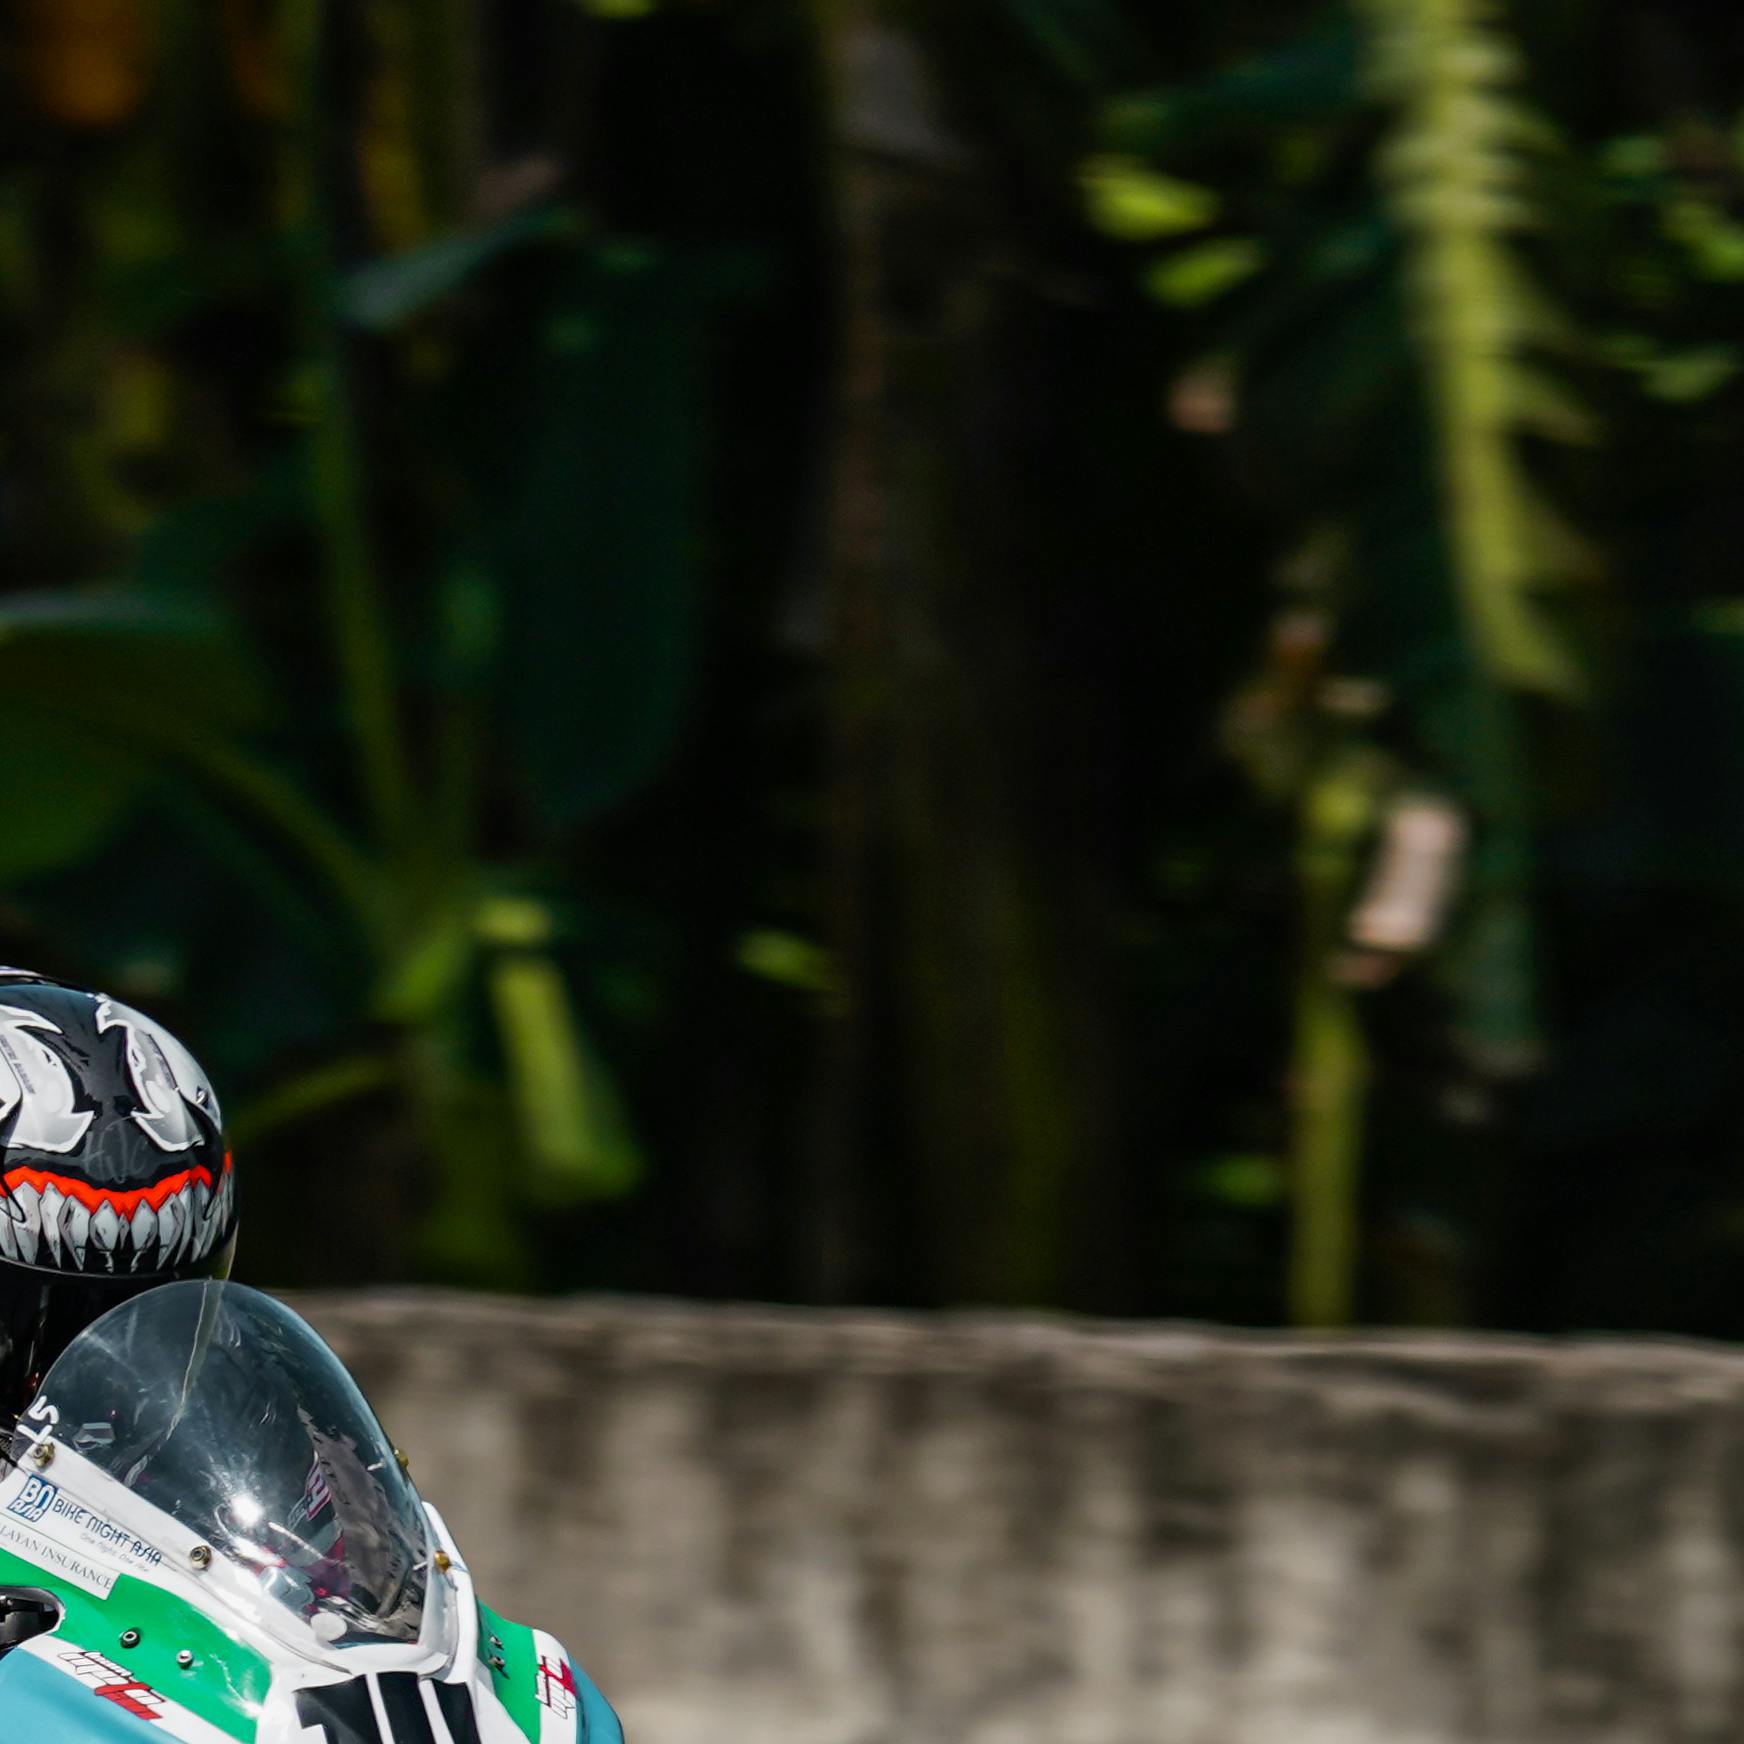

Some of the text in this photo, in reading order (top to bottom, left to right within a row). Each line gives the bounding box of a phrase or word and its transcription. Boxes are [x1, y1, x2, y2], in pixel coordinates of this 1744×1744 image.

[9, 1499, 45, 1523] ASIA
[52, 1496, 163, 1566] BIKE NIGHT ASIA
[40, 1547, 113, 1591] INSURANCE
